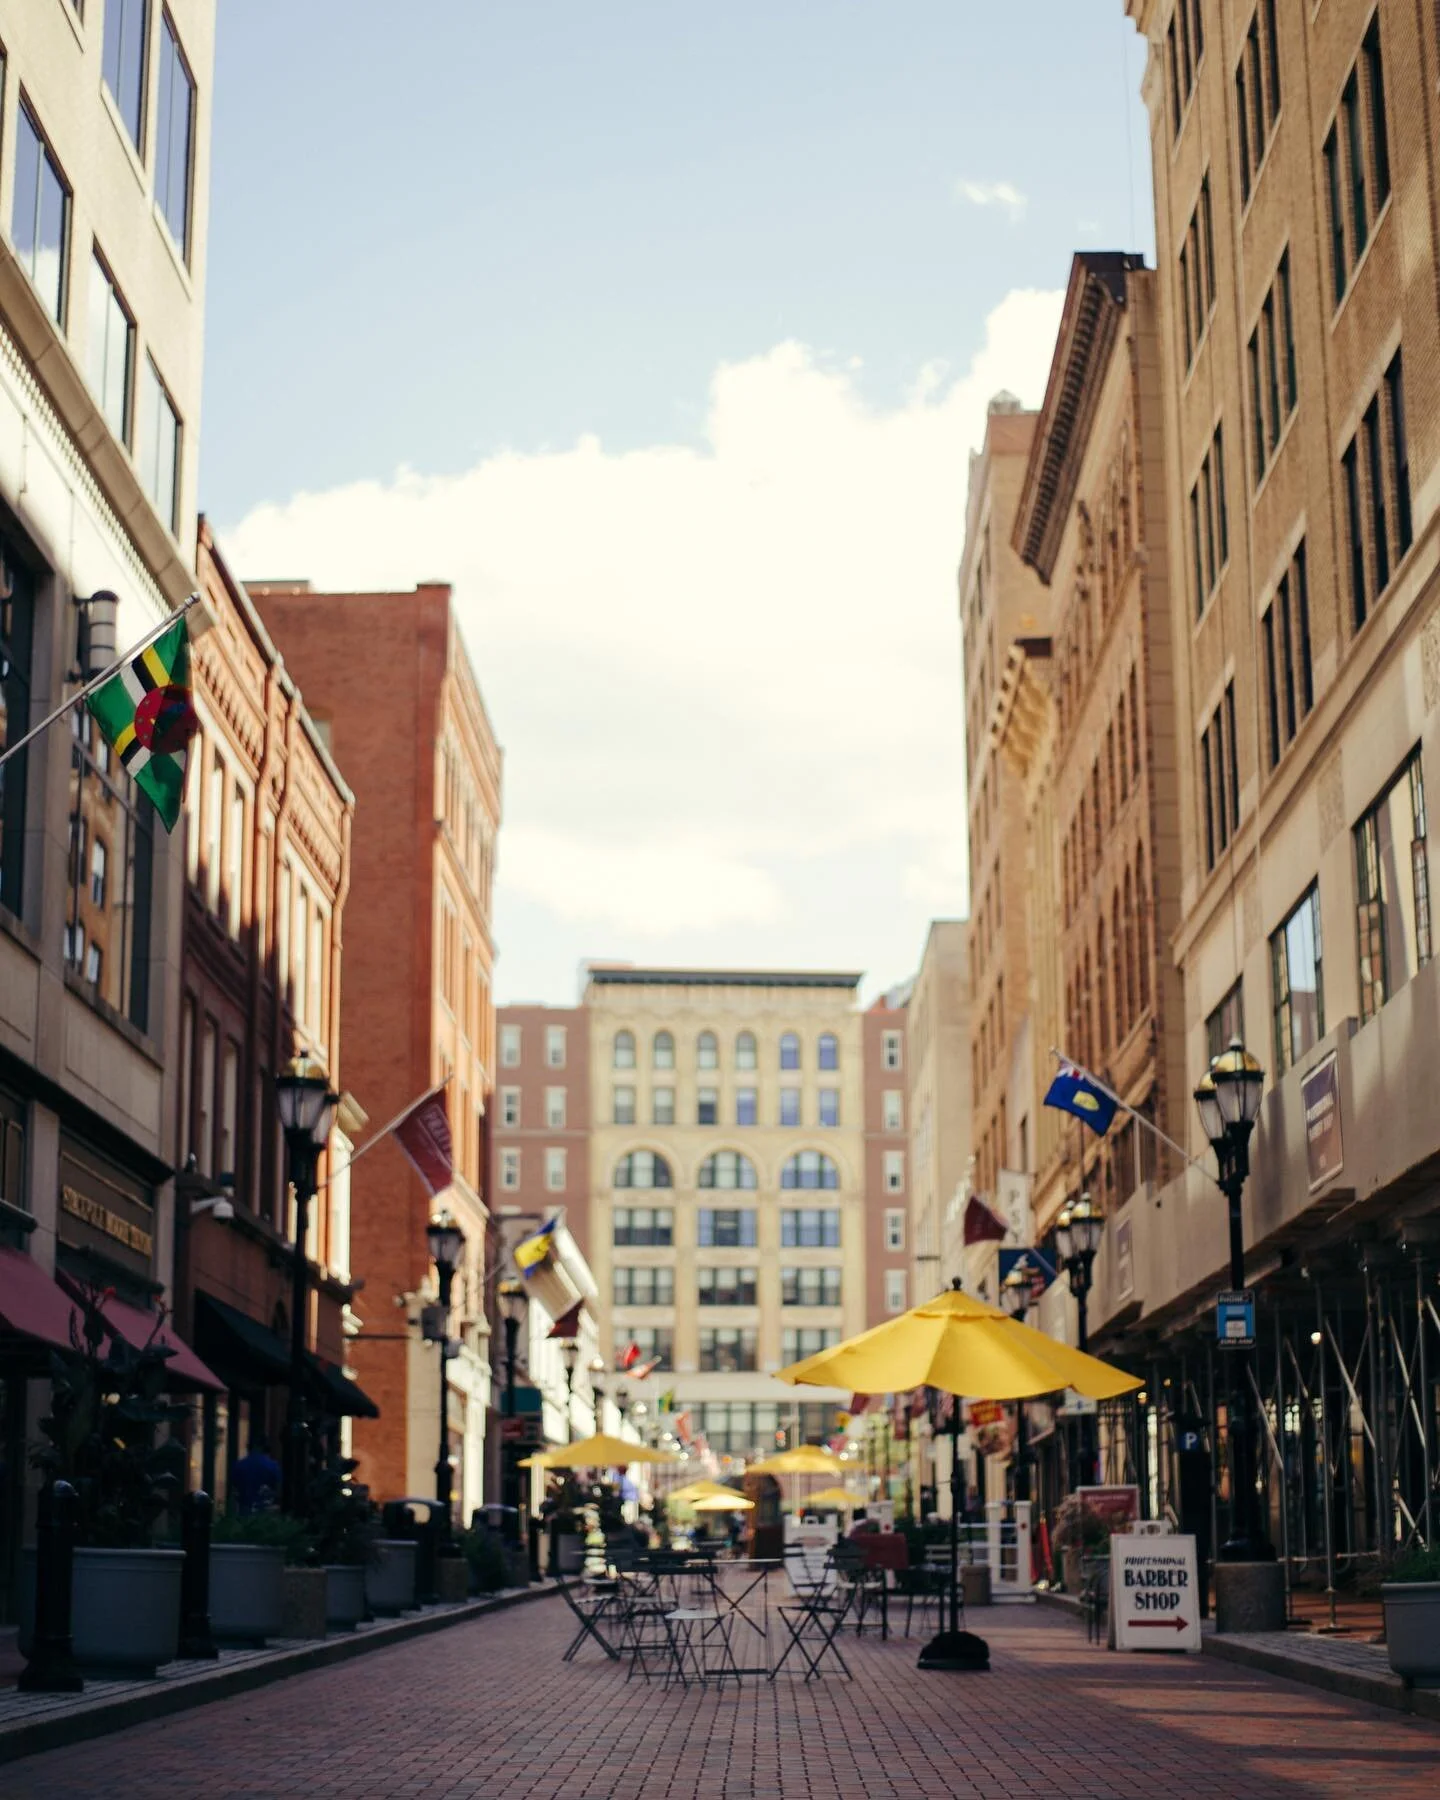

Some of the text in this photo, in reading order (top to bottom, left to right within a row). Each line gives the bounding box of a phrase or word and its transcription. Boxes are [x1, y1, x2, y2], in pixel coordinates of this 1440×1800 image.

[1185, 1432, 1197, 1450] P
[1124, 1569, 1188, 1587] BARBER
[1135, 1592, 1180, 1610] SHOP
